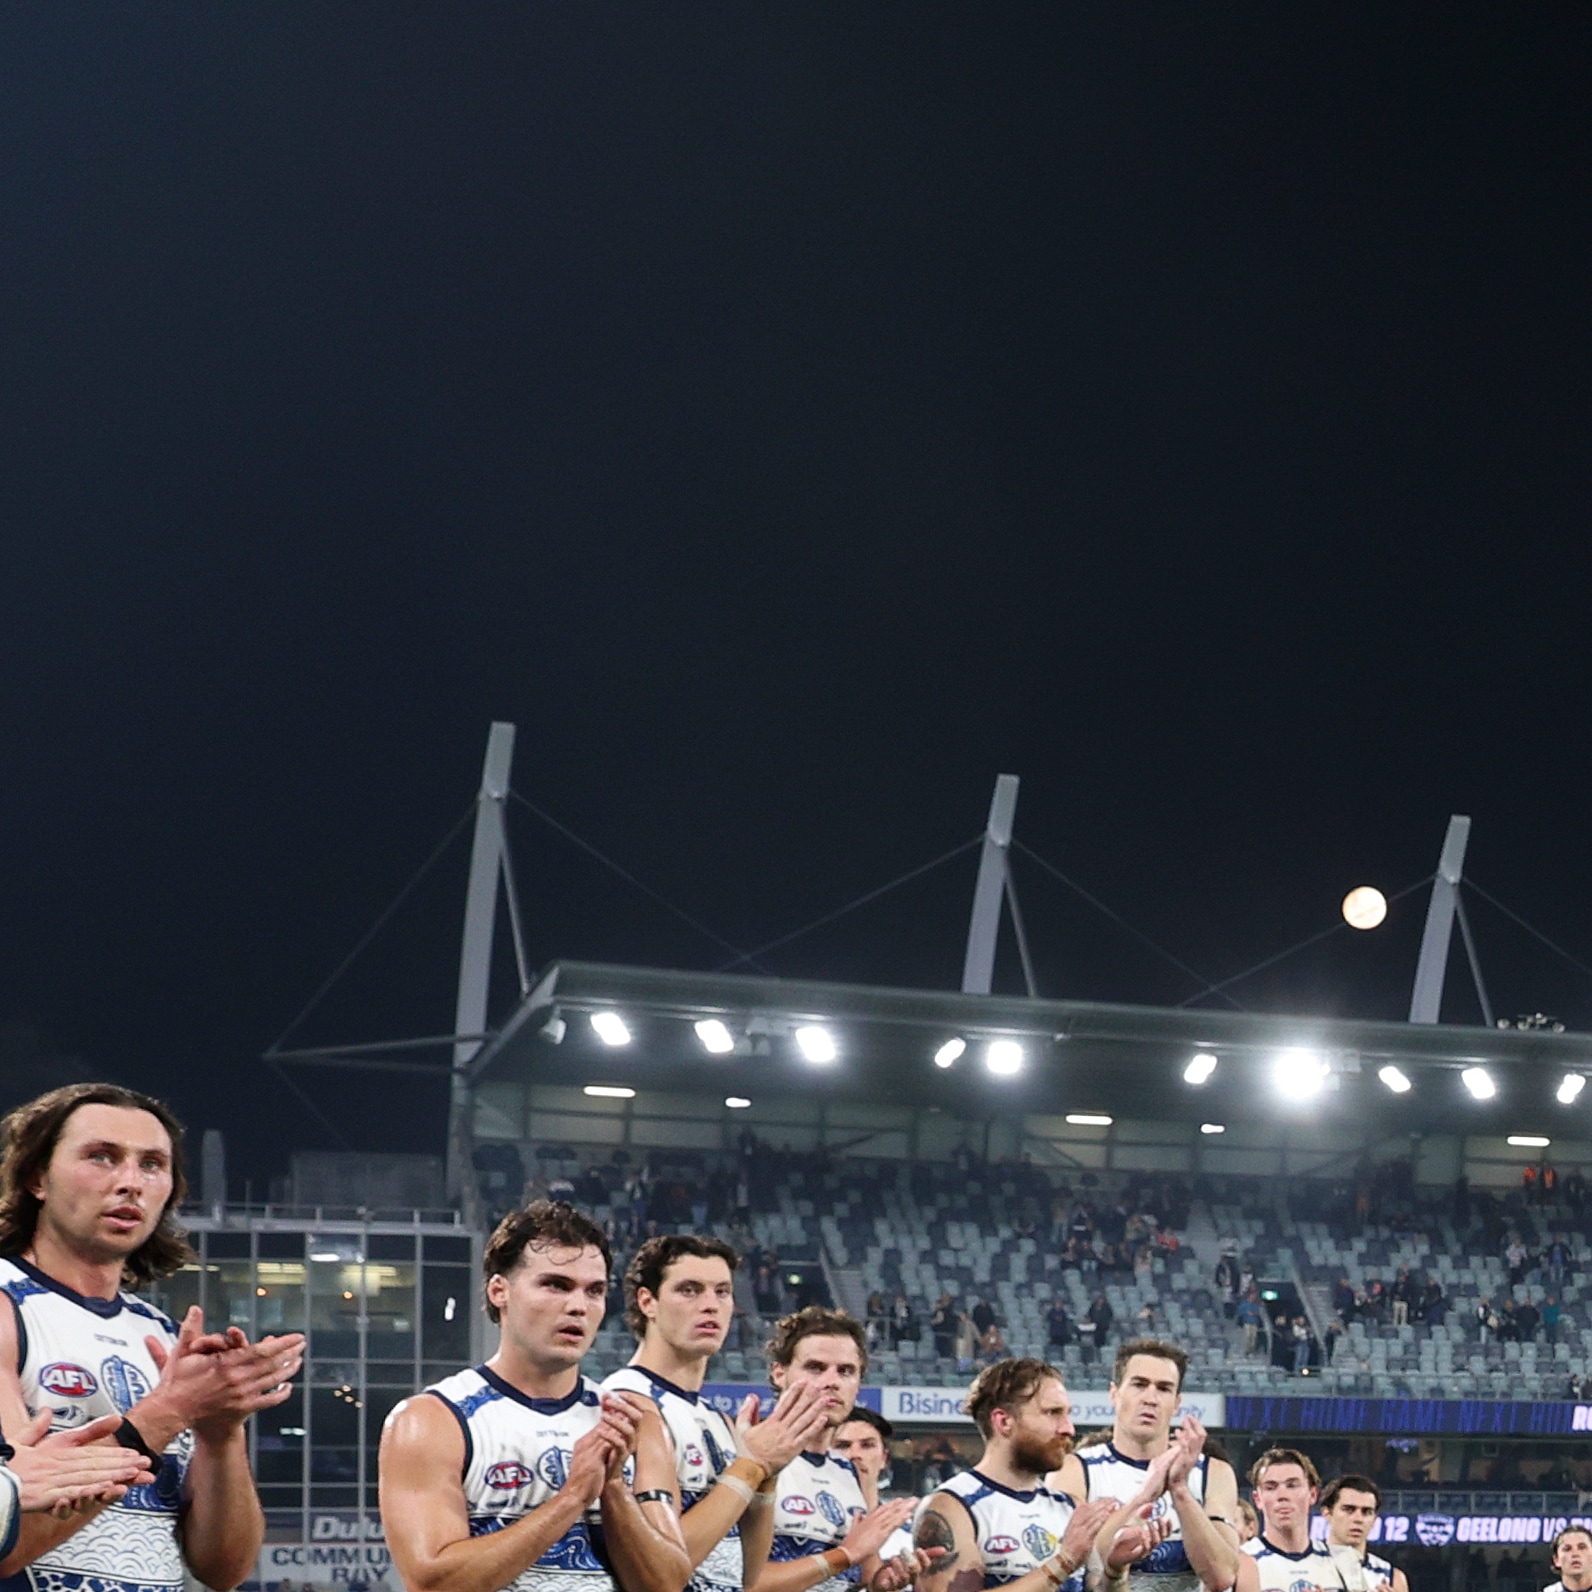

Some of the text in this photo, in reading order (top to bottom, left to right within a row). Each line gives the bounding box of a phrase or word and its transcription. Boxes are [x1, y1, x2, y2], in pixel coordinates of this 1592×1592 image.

[43, 1368, 98, 1391] AFL
[487, 1466, 532, 1484] AFL
[781, 1499, 816, 1514] AFL
[312, 1516, 384, 1539] Dulu
[1384, 1516, 1410, 1541] 12
[1456, 1517, 1540, 1542] GEELONG
